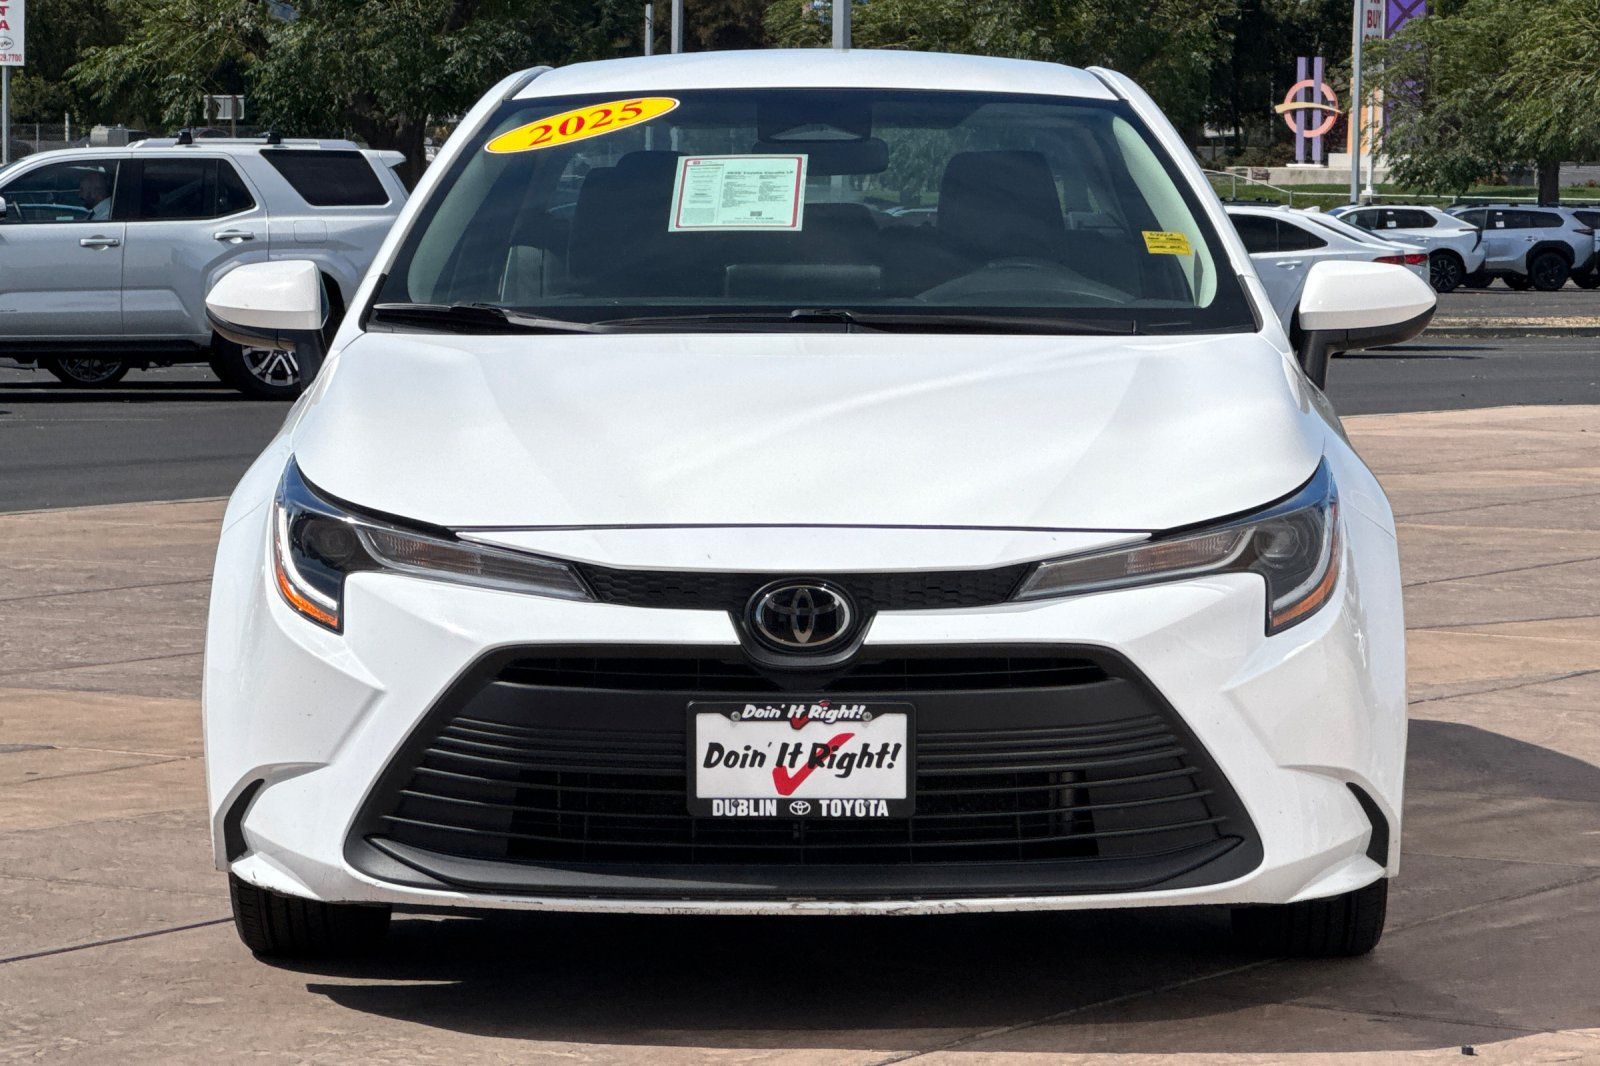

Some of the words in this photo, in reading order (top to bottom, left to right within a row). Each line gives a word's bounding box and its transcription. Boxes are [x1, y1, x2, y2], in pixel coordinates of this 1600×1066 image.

[1367, 10, 1381, 28] BUY
[528, 100, 643, 147] 2025
[741, 703, 785, 719] Doin'
[787, 704, 806, 719] It
[808, 704, 865, 723] Right!
[703, 741, 772, 769] Doin'
[775, 742, 804, 769] It
[807, 742, 902, 778] Right!
[712, 799, 777, 817] DUBLIN
[819, 799, 889, 817] TOYOTA
